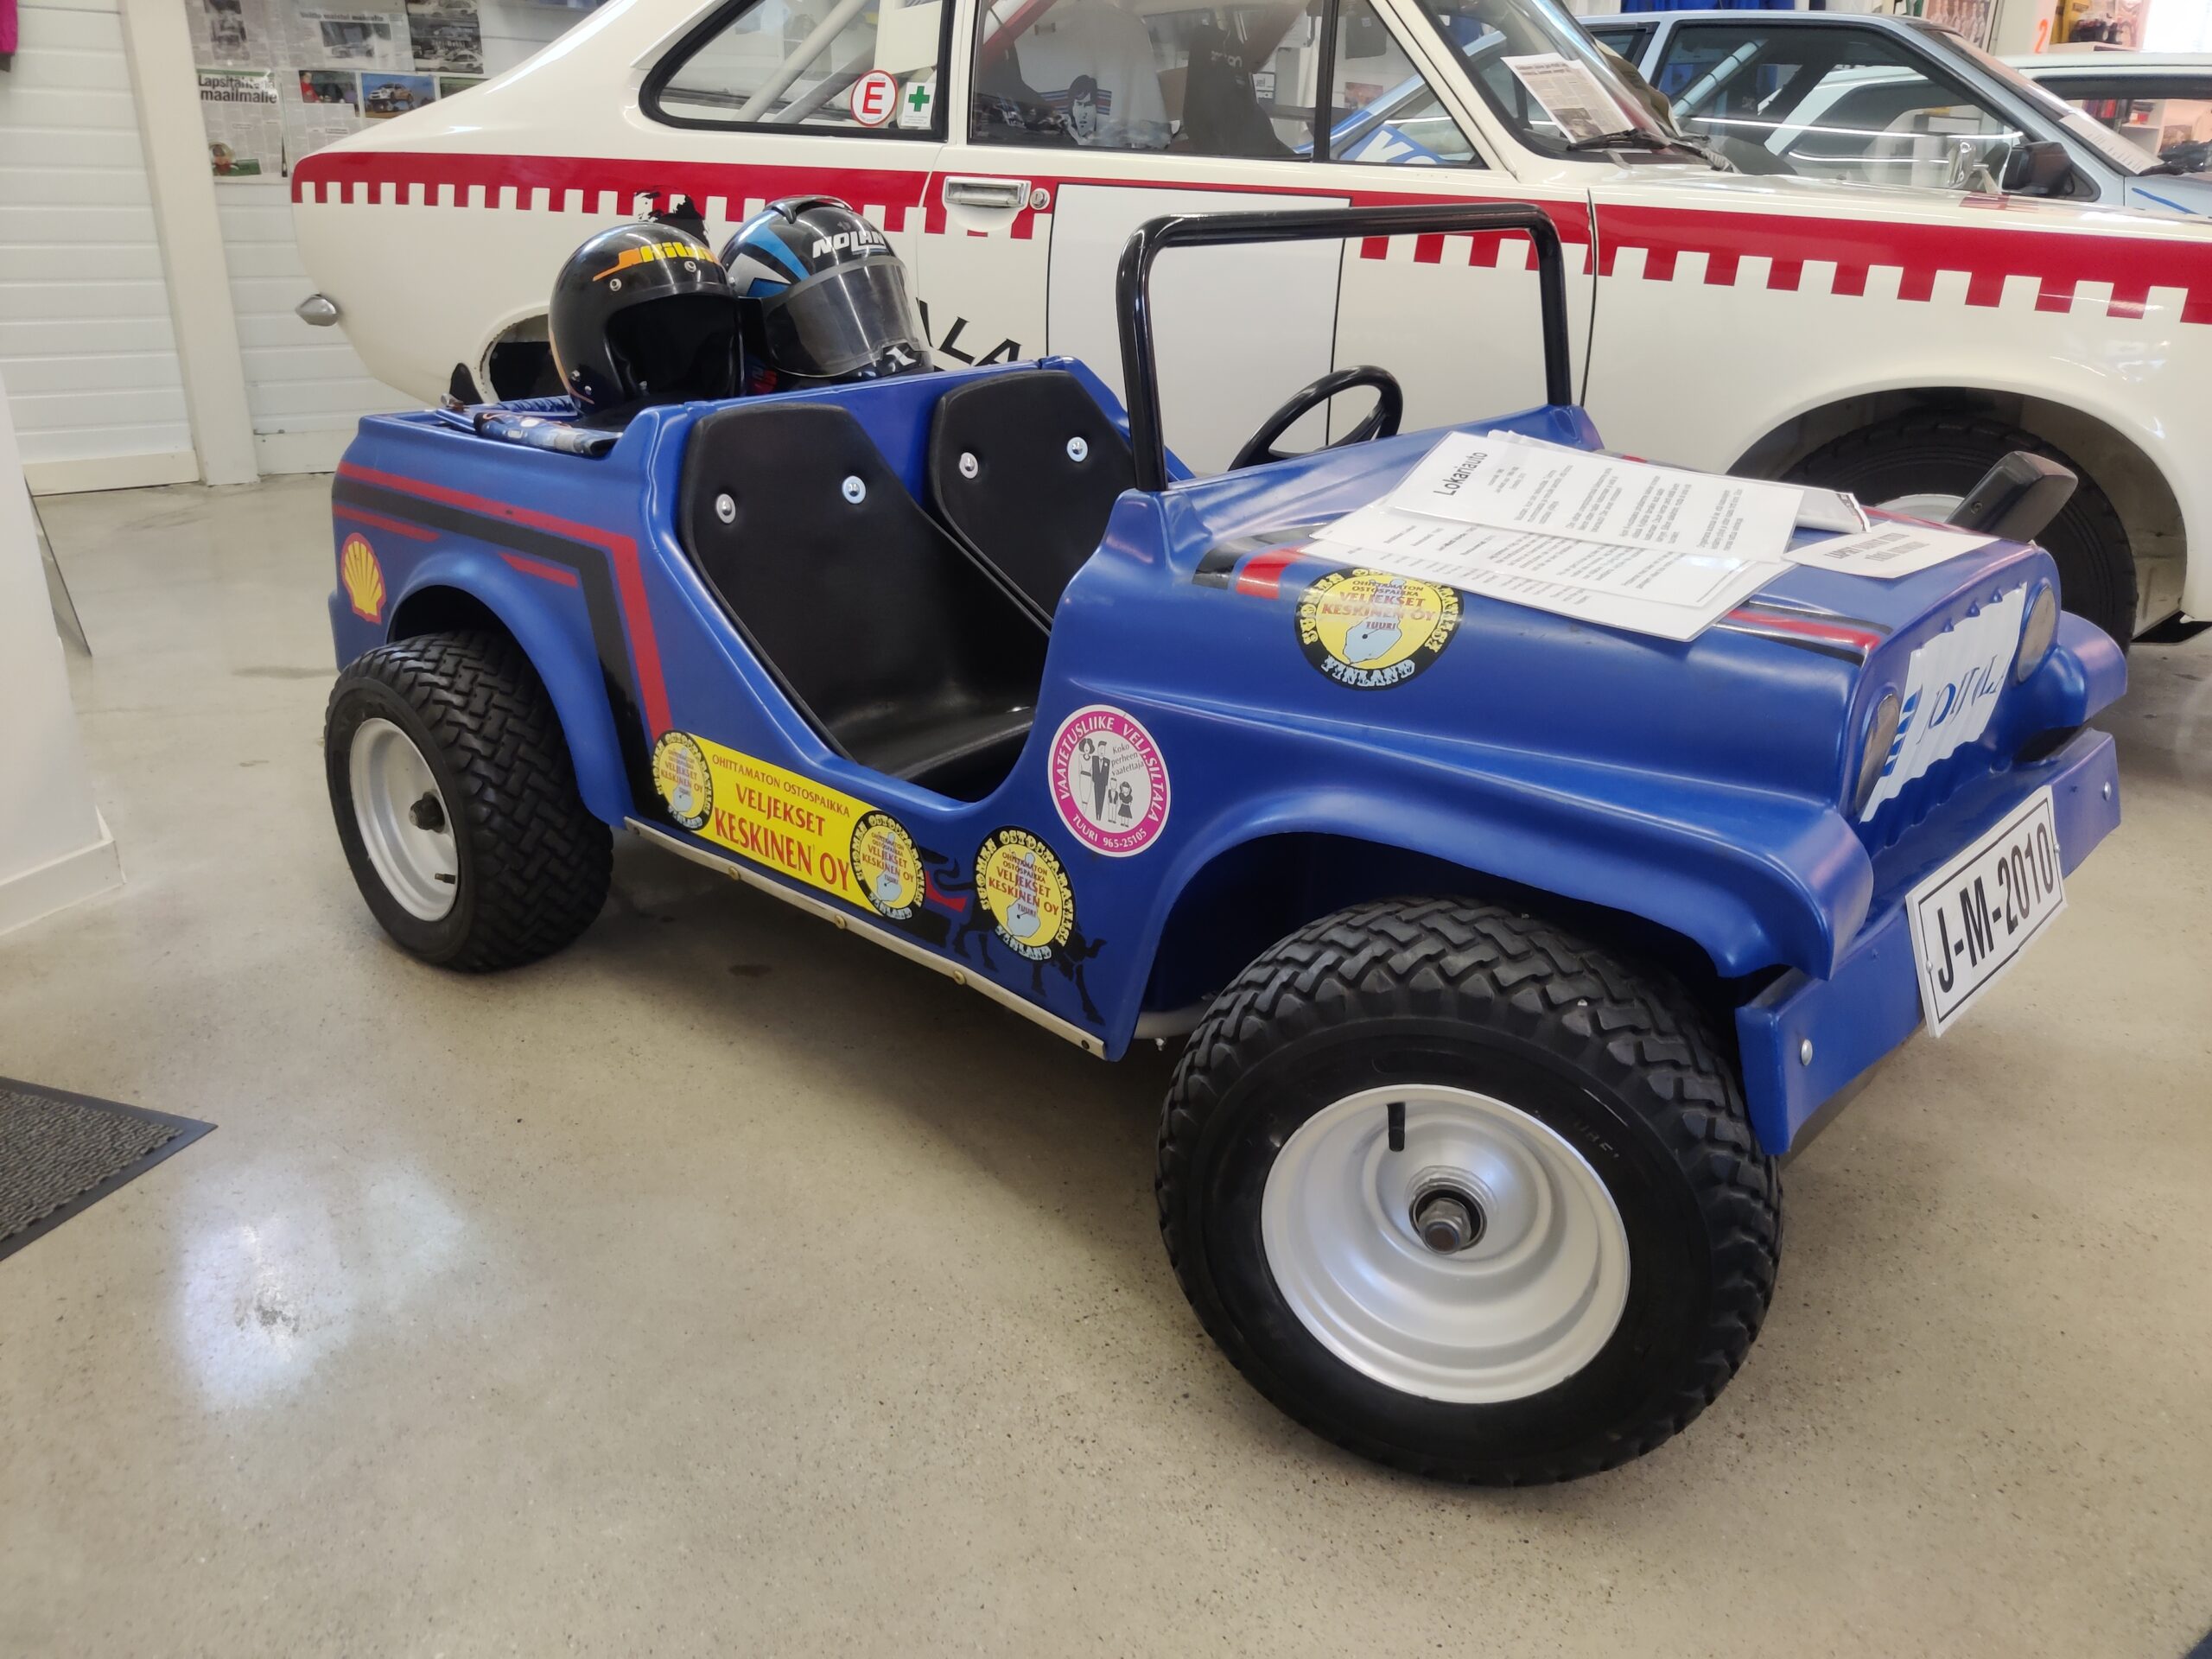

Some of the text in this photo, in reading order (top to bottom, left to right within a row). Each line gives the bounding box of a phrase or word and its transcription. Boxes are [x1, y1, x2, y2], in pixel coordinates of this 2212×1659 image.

[200, 87, 277, 104] maailmalle
[812, 230, 887, 258] NOLAN
[1433, 451, 1488, 496] Lokariauto
[1352, 580, 1424, 591] OHITTAMATON
[1321, 603, 1436, 622] KESKINEN OY
[1339, 592, 1427, 607] VELJEKSET
[1365, 621, 1396, 630] TUURI
[1321, 655, 1416, 687] FINLAND
[1056, 716, 1115, 800] VAATETUSLIIKE
[1111, 752, 1138, 767] perheen
[1112, 743, 1130, 754] Koko
[1112, 760, 1145, 777] vaatettaja
[712, 754, 780, 788] OHITTAMATON
[784, 781, 849, 817] OSTOSPAIKKA
[735, 784, 825, 836] VELJEKSET
[1072, 813, 1147, 849] TUURI 965-25105
[715, 807, 850, 892] KESKINEN OY
[868, 844, 907, 869] VELJEKSET
[903, 871, 914, 882] OY
[1001, 851, 1048, 876] OHITTAMATON
[996, 866, 1052, 898] VELJEKSET
[988, 876, 1059, 916] KESKINEN OY
[1937, 822, 2055, 994] J-M-2010
